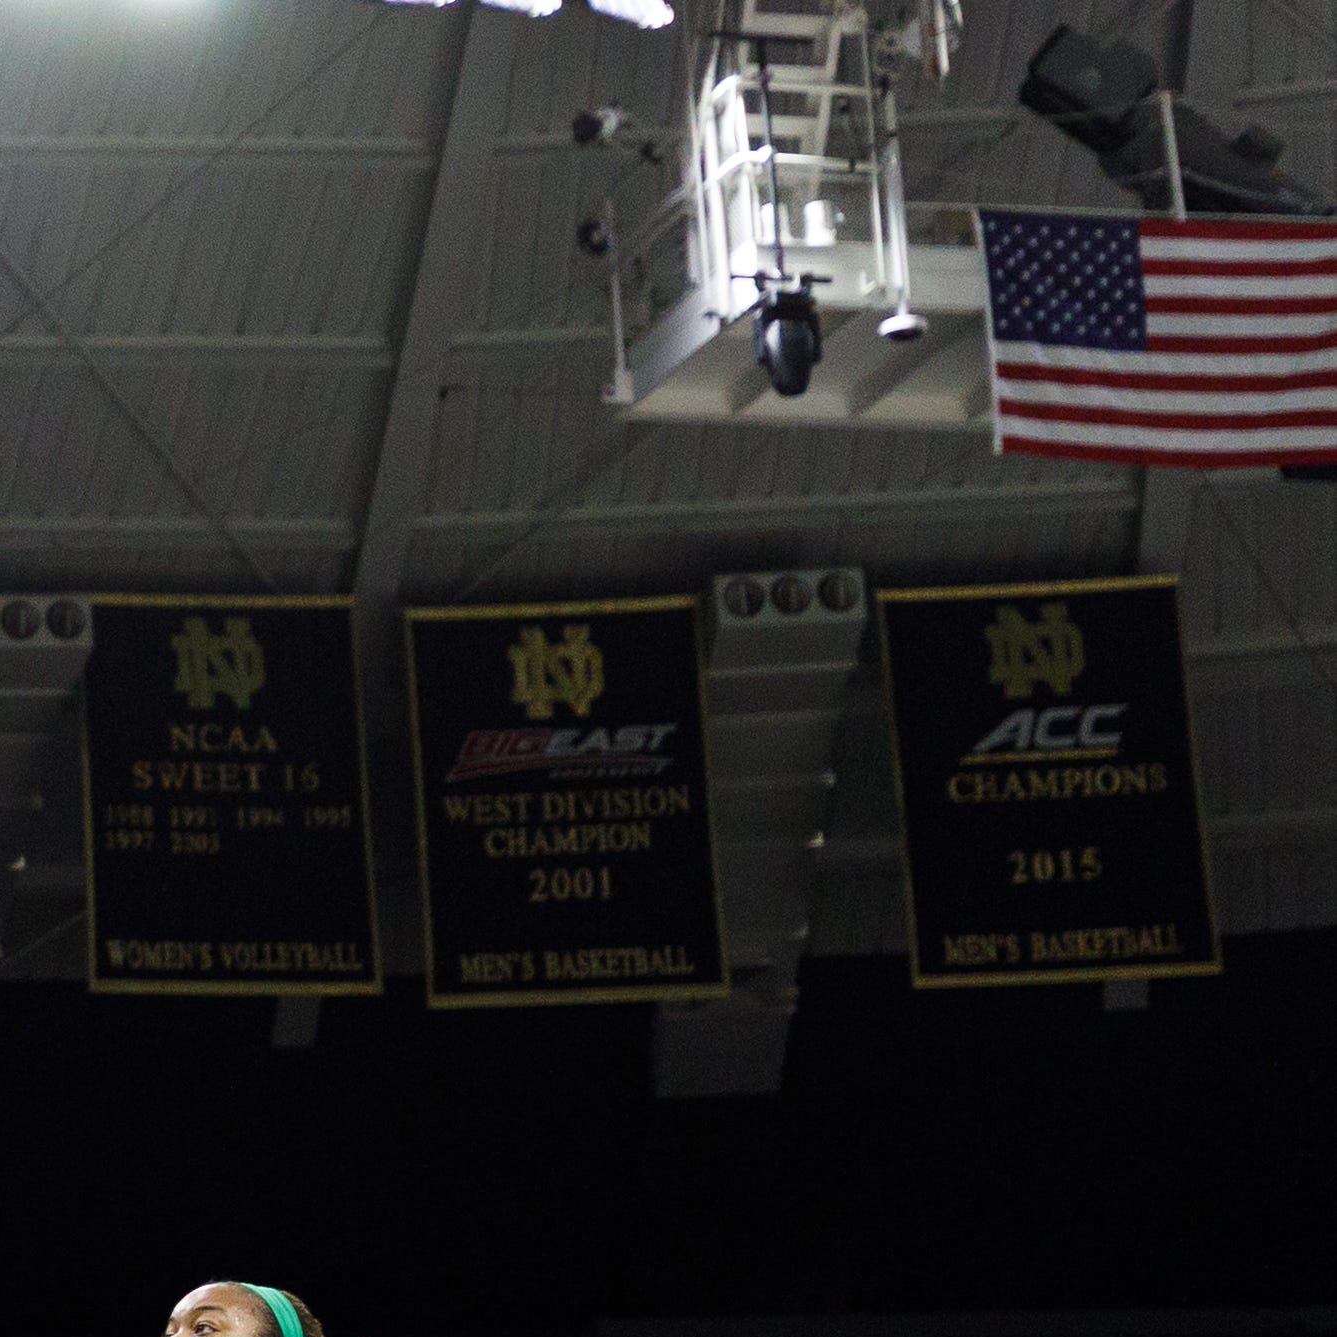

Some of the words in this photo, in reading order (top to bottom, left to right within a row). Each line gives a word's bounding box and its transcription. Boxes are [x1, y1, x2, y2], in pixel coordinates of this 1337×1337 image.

[169, 723, 278, 753] NCAA
[973, 703, 1129, 751] ACC
[130, 760, 268, 792] SWEET
[284, 764, 321, 792] 16
[947, 763, 1167, 803] CHAMPIONS
[442, 791, 532, 825] WEST
[542, 784, 691, 821] DIVISION
[484, 821, 652, 859] CHAMPION
[529, 866, 613, 903] 2001
[1008, 847, 1103, 885] 2015
[105, 939, 213, 971] WOMEN'S
[942, 932, 1021, 966] MEN'S
[1030, 922, 1184, 962] BASKETBALL
[459, 951, 534, 983] MEN'S
[544, 945, 695, 981] BASKETBALL
